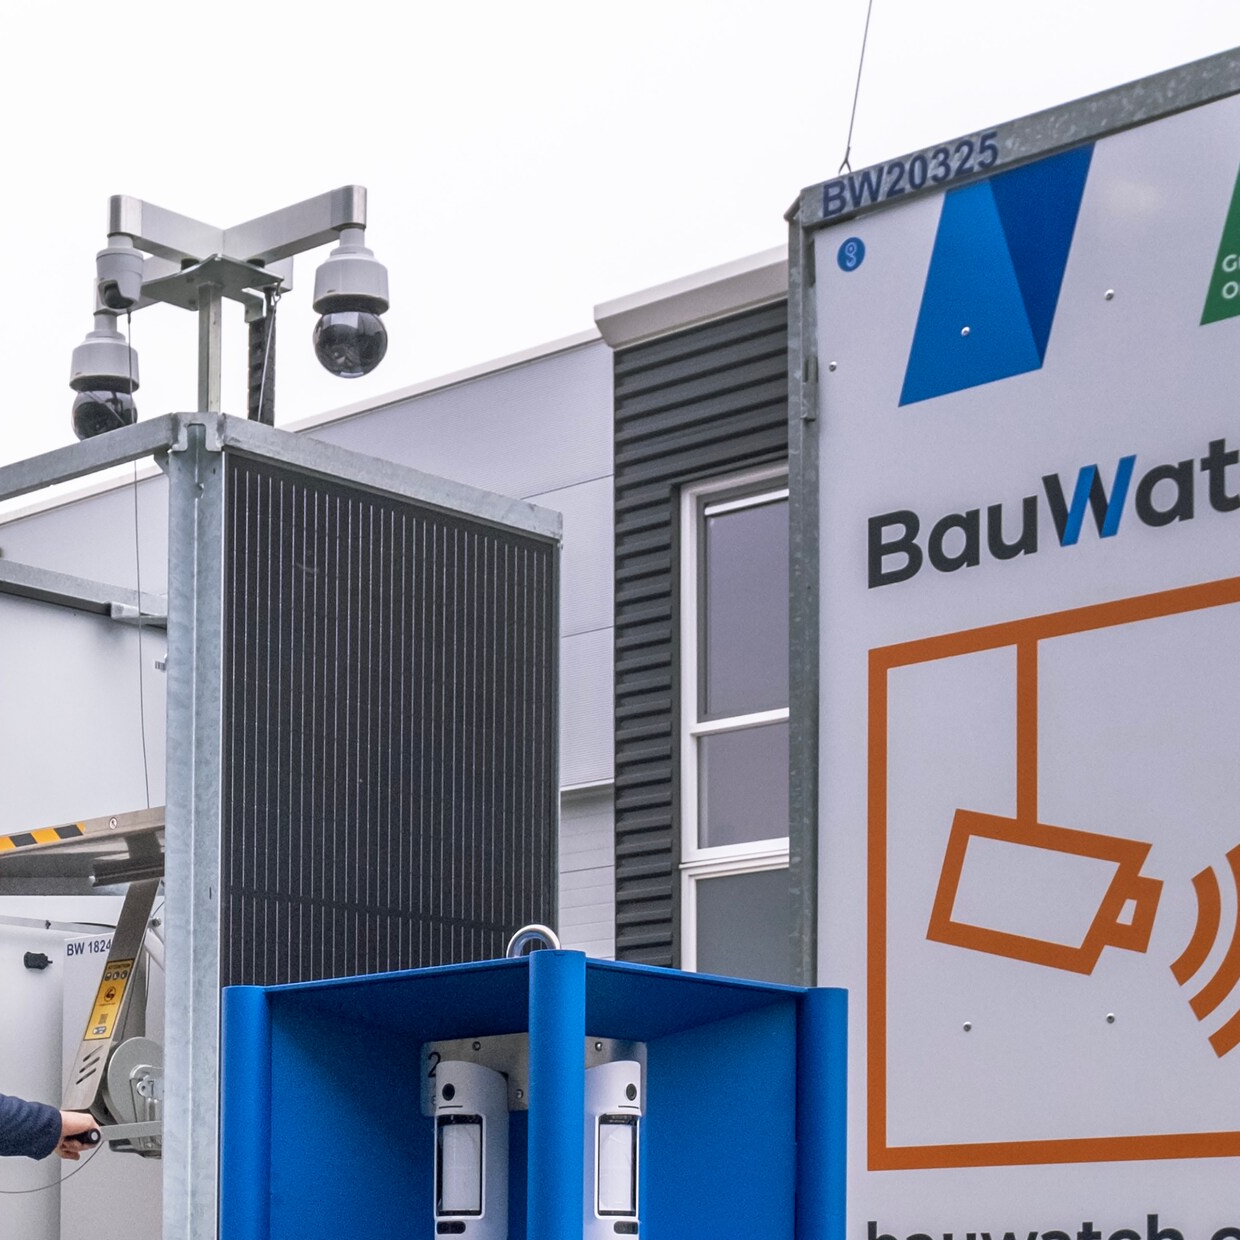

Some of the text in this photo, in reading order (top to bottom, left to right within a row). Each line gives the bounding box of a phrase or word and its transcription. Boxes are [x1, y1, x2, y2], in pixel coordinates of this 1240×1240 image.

[822, 131, 999, 218] BW20325
[66, 942, 85, 956] BW
[427, 1051, 441, 1078] 2
